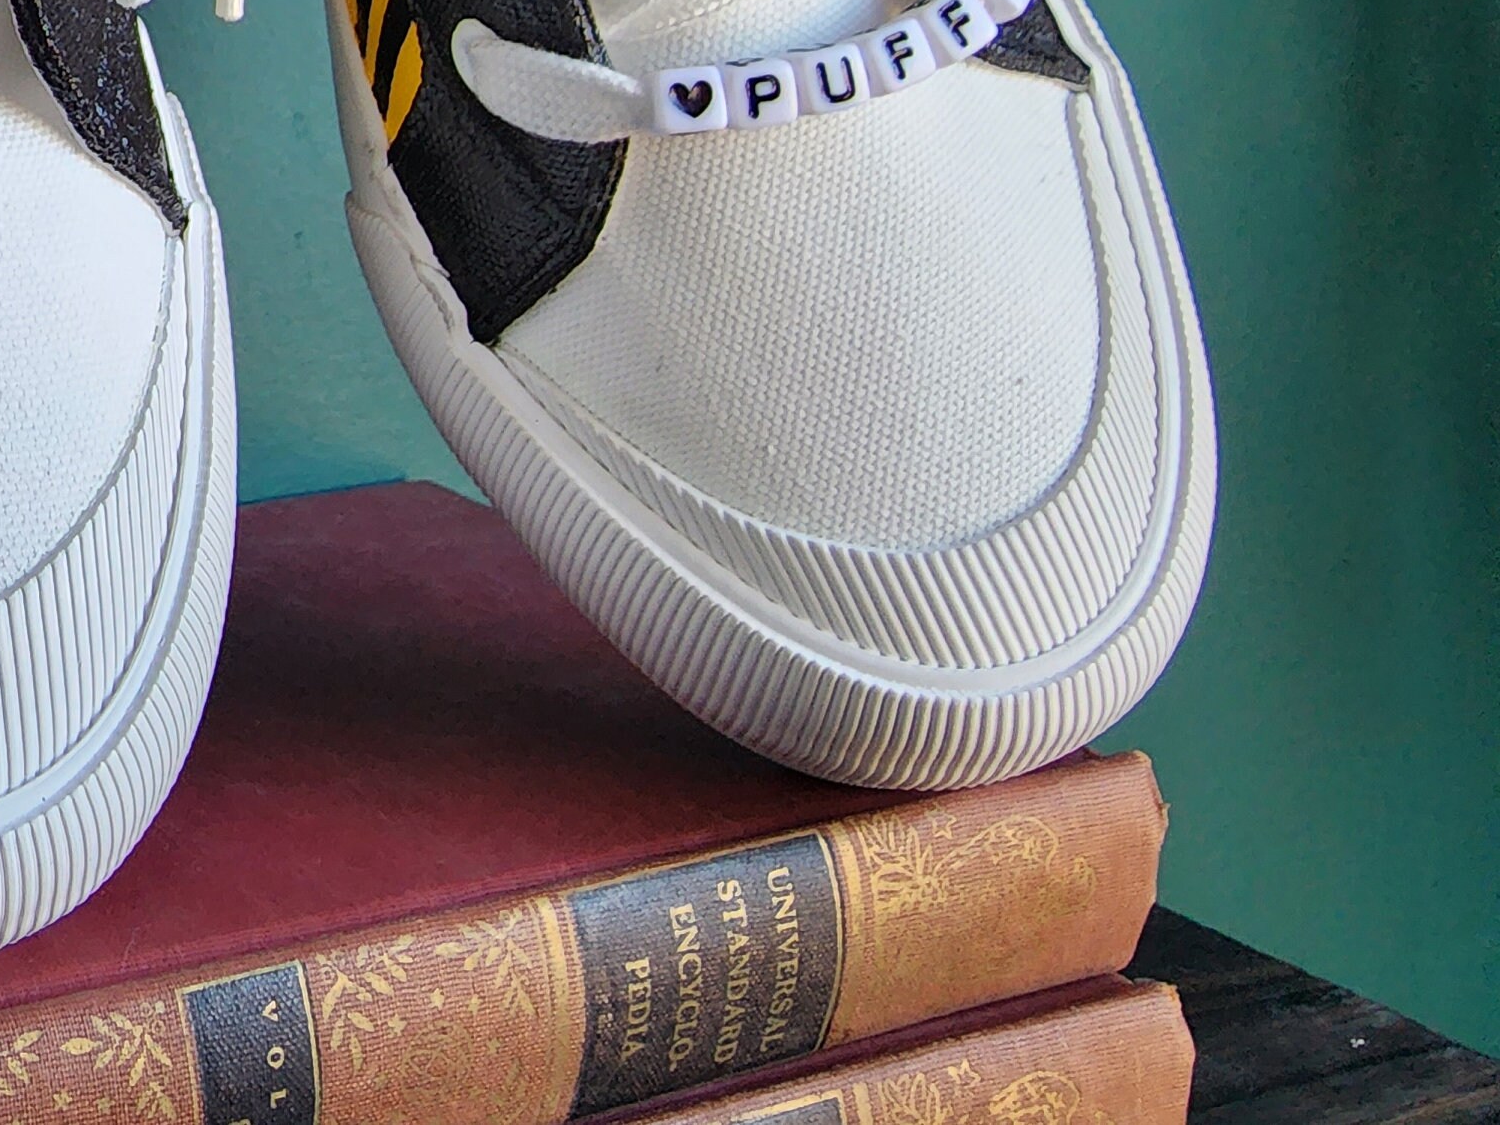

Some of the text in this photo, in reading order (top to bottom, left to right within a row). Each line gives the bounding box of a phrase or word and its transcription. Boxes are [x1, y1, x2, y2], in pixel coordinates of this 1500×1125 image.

[621, 956, 652, 1062] PEDIA
[714, 878, 750, 1064] STANDARD
[759, 866, 800, 1053] UNIVERSAL
